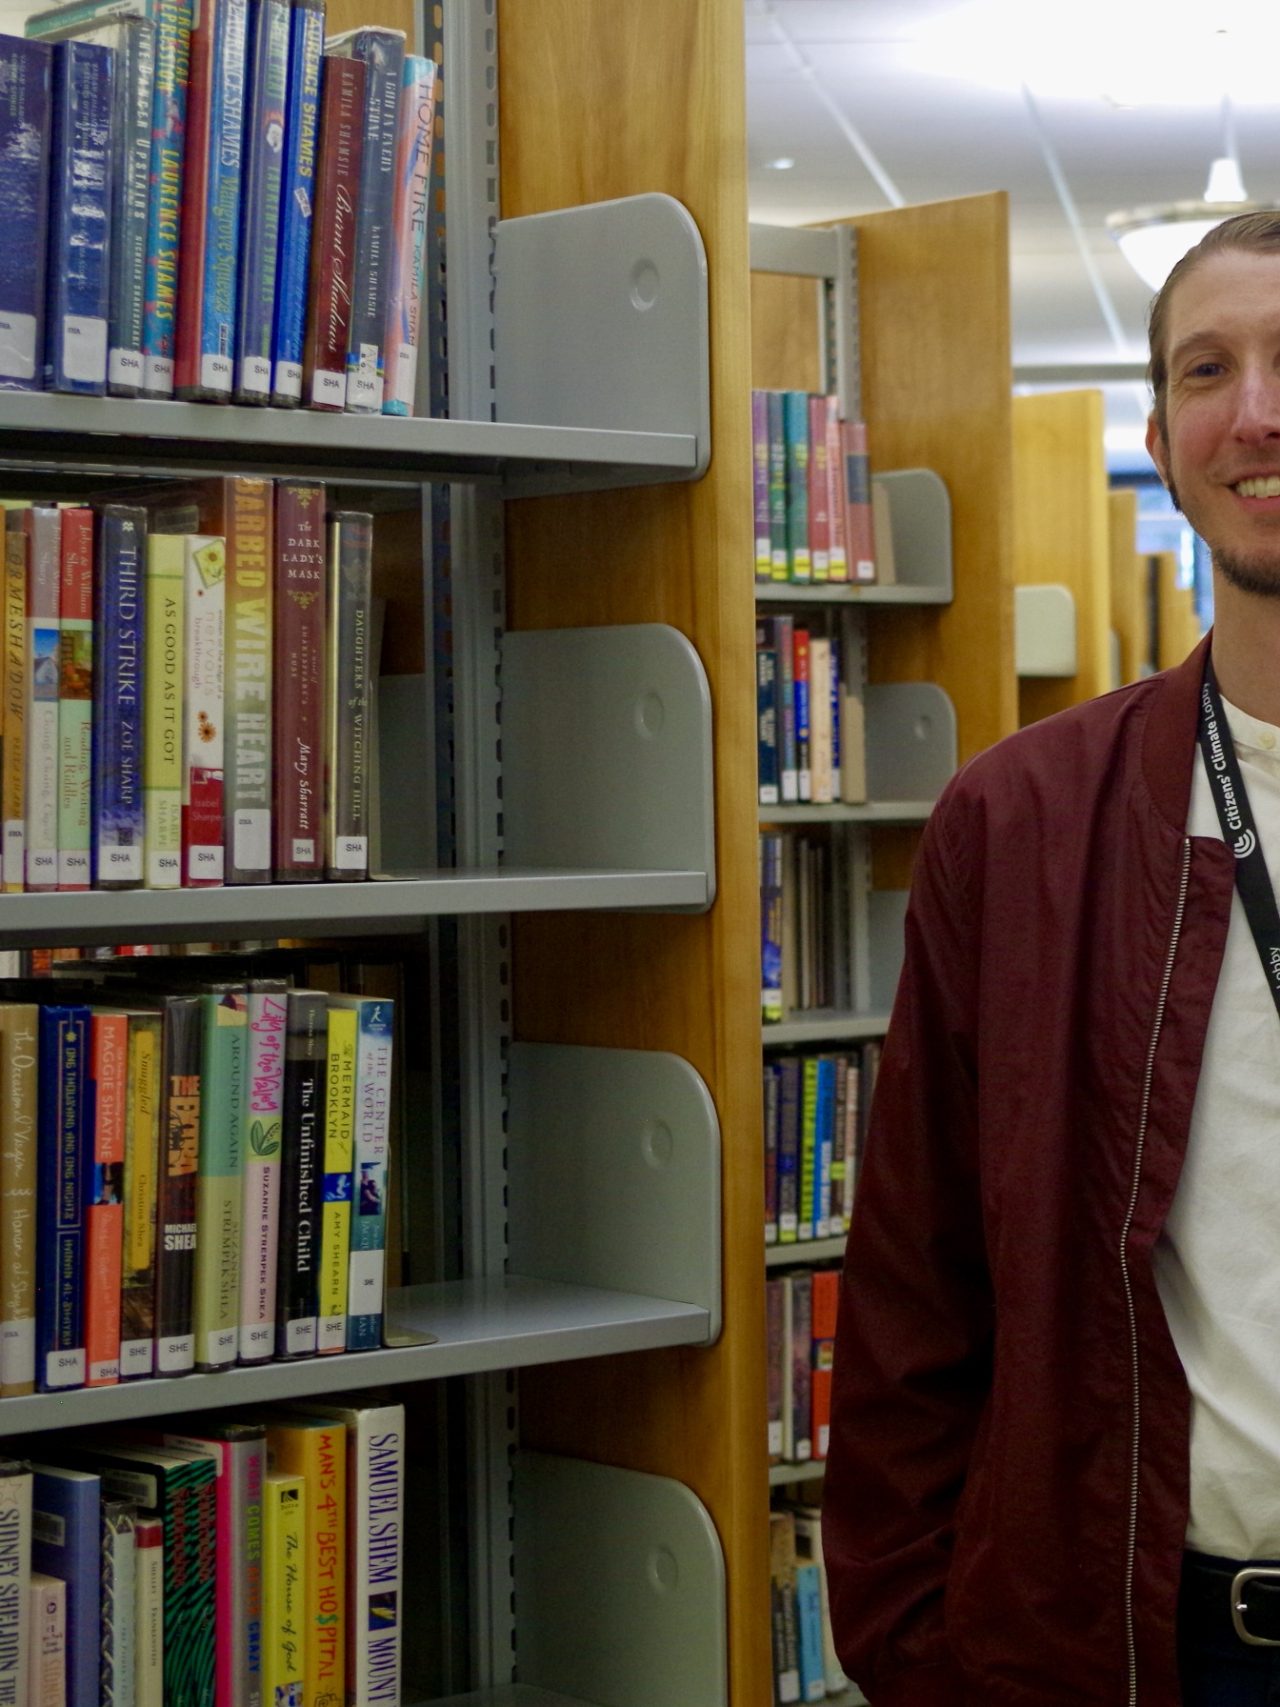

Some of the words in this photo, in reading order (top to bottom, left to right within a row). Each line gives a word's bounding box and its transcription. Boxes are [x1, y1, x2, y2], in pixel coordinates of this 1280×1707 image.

[136, 64, 153, 129] DANCER
[341, 72, 355, 117] KAMILA
[221, 96, 242, 168] SHAMES
[299, 102, 317, 177] SHAMES
[367, 97, 381, 142] STONE
[416, 84, 433, 167] HOME
[337, 124, 351, 176] SHAMSIE
[381, 132, 394, 173] EVERY
[134, 139, 150, 220] UPSTAIRS
[160, 149, 180, 242] LAURENCE
[212, 176, 241, 252] Mangrove
[332, 184, 355, 259] Burnt
[411, 174, 427, 235] FIRE
[134, 235, 143, 280] NICHOLAS
[370, 226, 382, 266] KAMILA
[156, 248, 177, 320] SHAMES
[212, 254, 237, 315] Squeeze
[367, 271, 378, 319] SHAMSIE
[409, 244, 421, 301] KAMILA
[132, 284, 143, 346] SHAKESPEARE
[328, 258, 352, 353] Shadows
[120, 358, 139, 369] SHA
[153, 364, 170, 374] SHA
[212, 362, 229, 372] SHA
[322, 377, 340, 388] SHA
[357, 380, 375, 391] SHA
[235, 479, 269, 588] BARBED
[288, 538, 320, 549] DARK
[66, 552, 78, 586] Sharp
[282, 553, 324, 565] LADY'S
[288, 569, 321, 580] MASK
[80, 571, 92, 614] William
[118, 546, 136, 621] THIRD
[165, 597, 177, 617] AS
[118, 628, 136, 706] STRIKE
[164, 623, 176, 674] GOOD
[191, 616, 204, 690] breakthrough
[203, 611, 217, 696] nervous
[235, 597, 266, 702] WIRE
[354, 609, 364, 689] DAUGHTERS
[164, 681, 176, 701] AS
[164, 706, 175, 723] IT
[64, 737, 77, 760] and
[164, 728, 175, 765] GOT
[235, 712, 266, 803] HEART
[294, 737, 312, 776] Mary
[352, 714, 363, 785] WITCHING
[1207, 719, 1228, 772] Climate
[64, 764, 77, 810] Riddles
[120, 757, 133, 804] SHARP
[157, 800, 169, 848] SHARPE
[298, 779, 313, 830] Sharratt
[352, 790, 361, 821] HILL
[35, 856, 53, 866] SHA
[66, 857, 87, 866] SHA
[110, 854, 131, 862] SHA
[158, 858, 178, 868] SHA
[198, 853, 215, 862] SHA
[295, 846, 311, 855] SHA
[346, 843, 363, 852] SHA
[251, 997, 288, 1033] Lily
[13, 1026, 36, 1051] The
[102, 1026, 116, 1090] MAGGIE
[259, 1035, 281, 1052] of
[138, 1050, 152, 1114] Smuggled
[230, 1034, 242, 1108] AROUND
[257, 1053, 280, 1073] the
[377, 1046, 389, 1078] THE
[11, 1054, 36, 1127] Occasional
[171, 1075, 200, 1096] THE
[252, 1067, 283, 1112] Valley
[301, 1079, 314, 1108] The
[329, 1053, 341, 1139] BROOKLYN
[341, 1060, 352, 1140] MERMAID
[100, 1095, 114, 1159] SHAYNE
[362, 1082, 375, 1143] WORLD
[374, 1088, 388, 1156] CENTER
[229, 1113, 241, 1167] AGAIN
[299, 1112, 316, 1213] Unfinished
[262, 1166, 271, 1222] SUZANNE
[12, 1208, 30, 1256] Hanan
[136, 1223, 146, 1247] Shea
[164, 1235, 196, 1251] SHEA
[165, 1224, 196, 1234] MICHAEL
[297, 1219, 312, 1273] Child
[333, 1211, 342, 1238] AMY
[260, 1224, 269, 1284] STREMPEK
[331, 1243, 341, 1295] SHEARN
[220, 1280, 230, 1319] SHEA
[259, 1288, 268, 1320] SHEA
[168, 1343, 188, 1353] SHE
[218, 1335, 233, 1345] SHE
[250, 1331, 269, 1341] SHE
[295, 1325, 312, 1335] SHE
[326, 1322, 343, 1332] SHE
[58, 1357, 78, 1367] SHA
[100, 1368, 118, 1377] SHA
[129, 1347, 147, 1356] SHE
[316, 1433, 337, 1490] MAN'S
[367, 1432, 399, 1521] SAMUEL
[245, 1504, 261, 1560] COMES
[317, 1494, 338, 1528] 4TH
[0, 1508, 20, 1577] SIDNEY
[284, 1531, 299, 1558] The
[316, 1531, 337, 1580] BEST
[367, 1522, 398, 1584] SHEM
[285, 1563, 299, 1614] House
[0, 1583, 20, 1671] SHELDON
[246, 1620, 261, 1672] CRAZY
[281, 1620, 297, 1636] of
[281, 1641, 297, 1673] God
[367, 1636, 397, 1702] MOUNT
